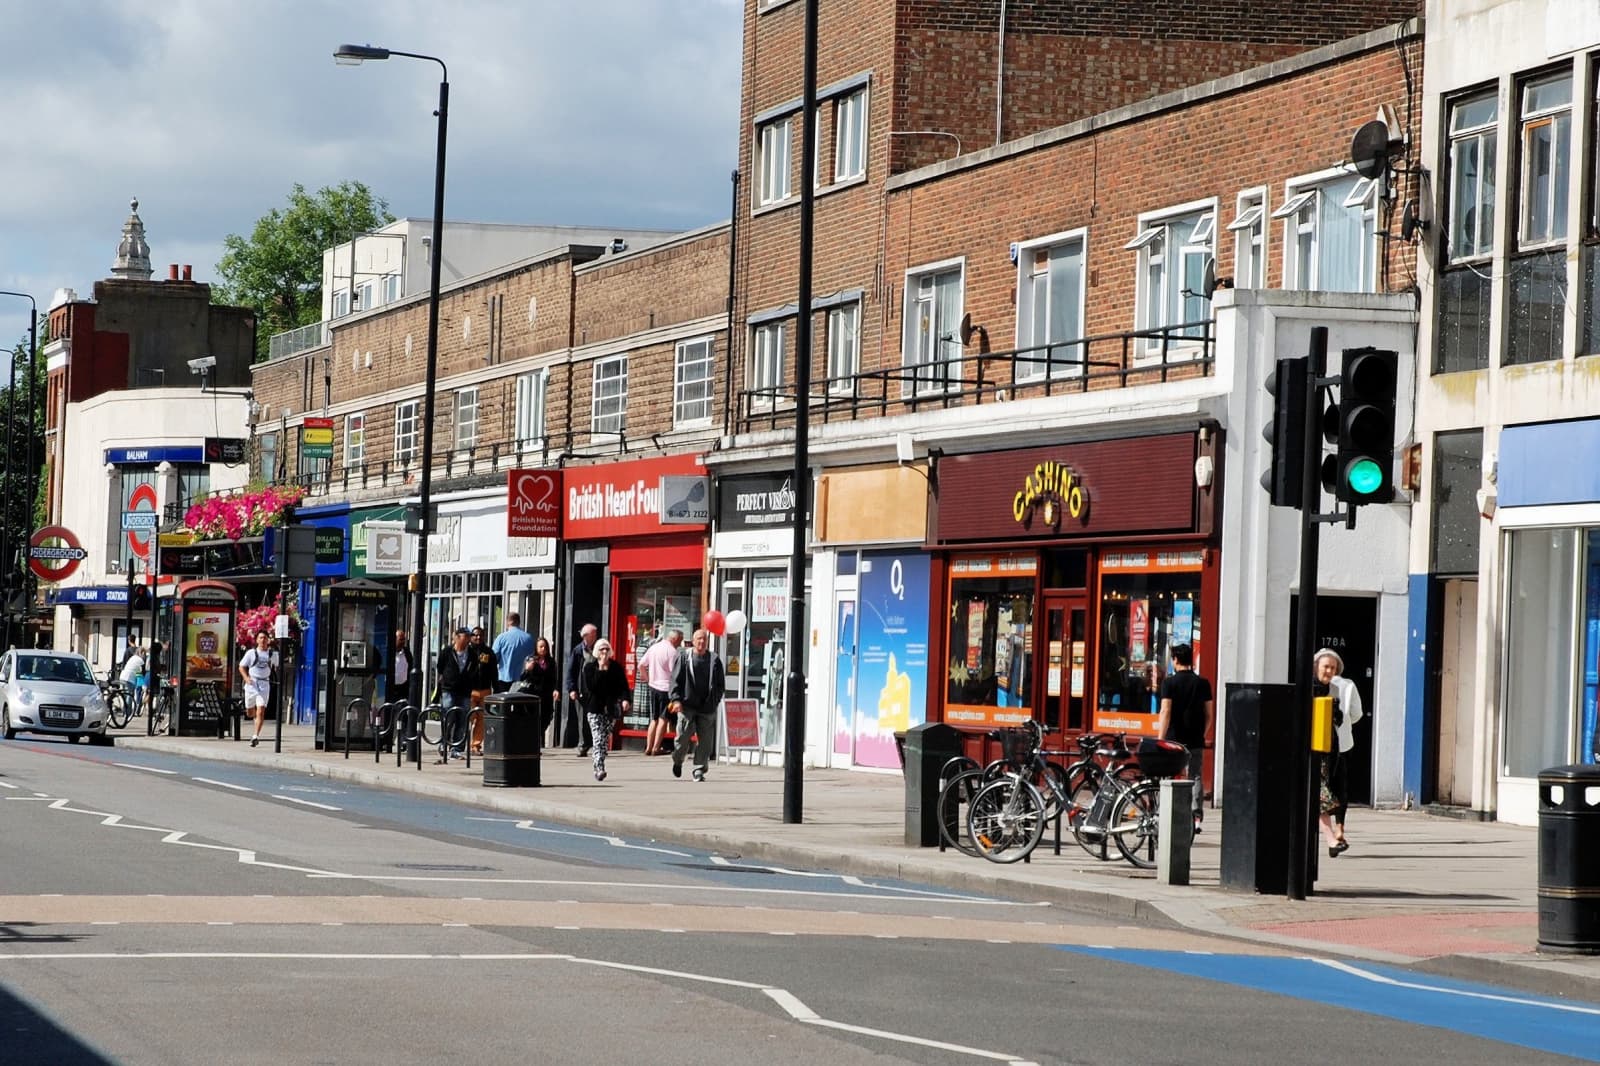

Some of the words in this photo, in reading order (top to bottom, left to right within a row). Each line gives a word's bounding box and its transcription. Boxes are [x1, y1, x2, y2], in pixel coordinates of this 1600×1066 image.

[126, 451, 148, 460] BALHAM
[1013, 461, 1082, 522] CASHINO
[569, 483, 603, 520] British
[605, 483, 635, 517] Heart
[637, 480, 660, 515] Fou
[736, 492, 767, 511] PERFECT
[512, 524, 557, 532] Foundation
[31, 547, 85, 559] NDERGROUND
[76, 590, 98, 600] BALHAM
[106, 591, 128, 601] STATION
[1321, 636, 1346, 647] 178A
